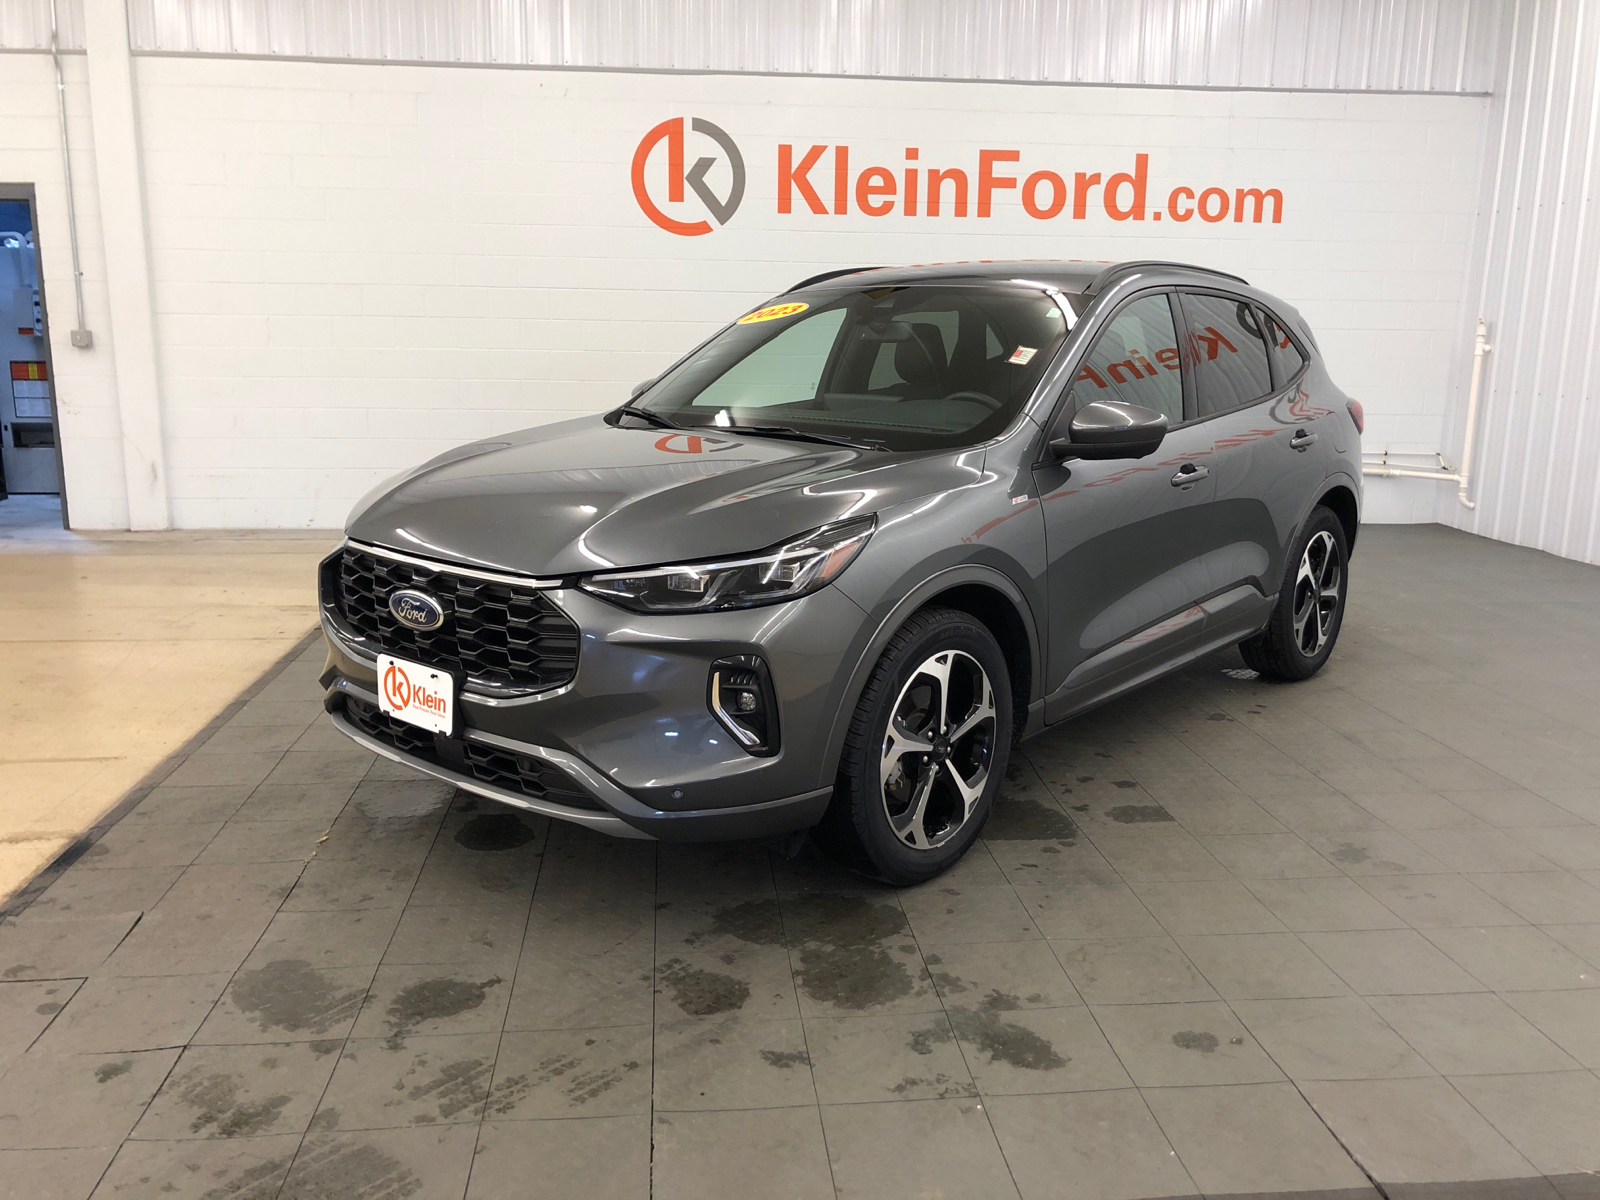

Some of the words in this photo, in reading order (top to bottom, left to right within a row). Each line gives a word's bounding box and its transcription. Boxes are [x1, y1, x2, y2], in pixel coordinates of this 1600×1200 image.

[777, 144, 1284, 224] KleinFord.com
[742, 304, 804, 322] 2023
[398, 597, 428, 623] Ford
[413, 684, 446, 713] Klein
